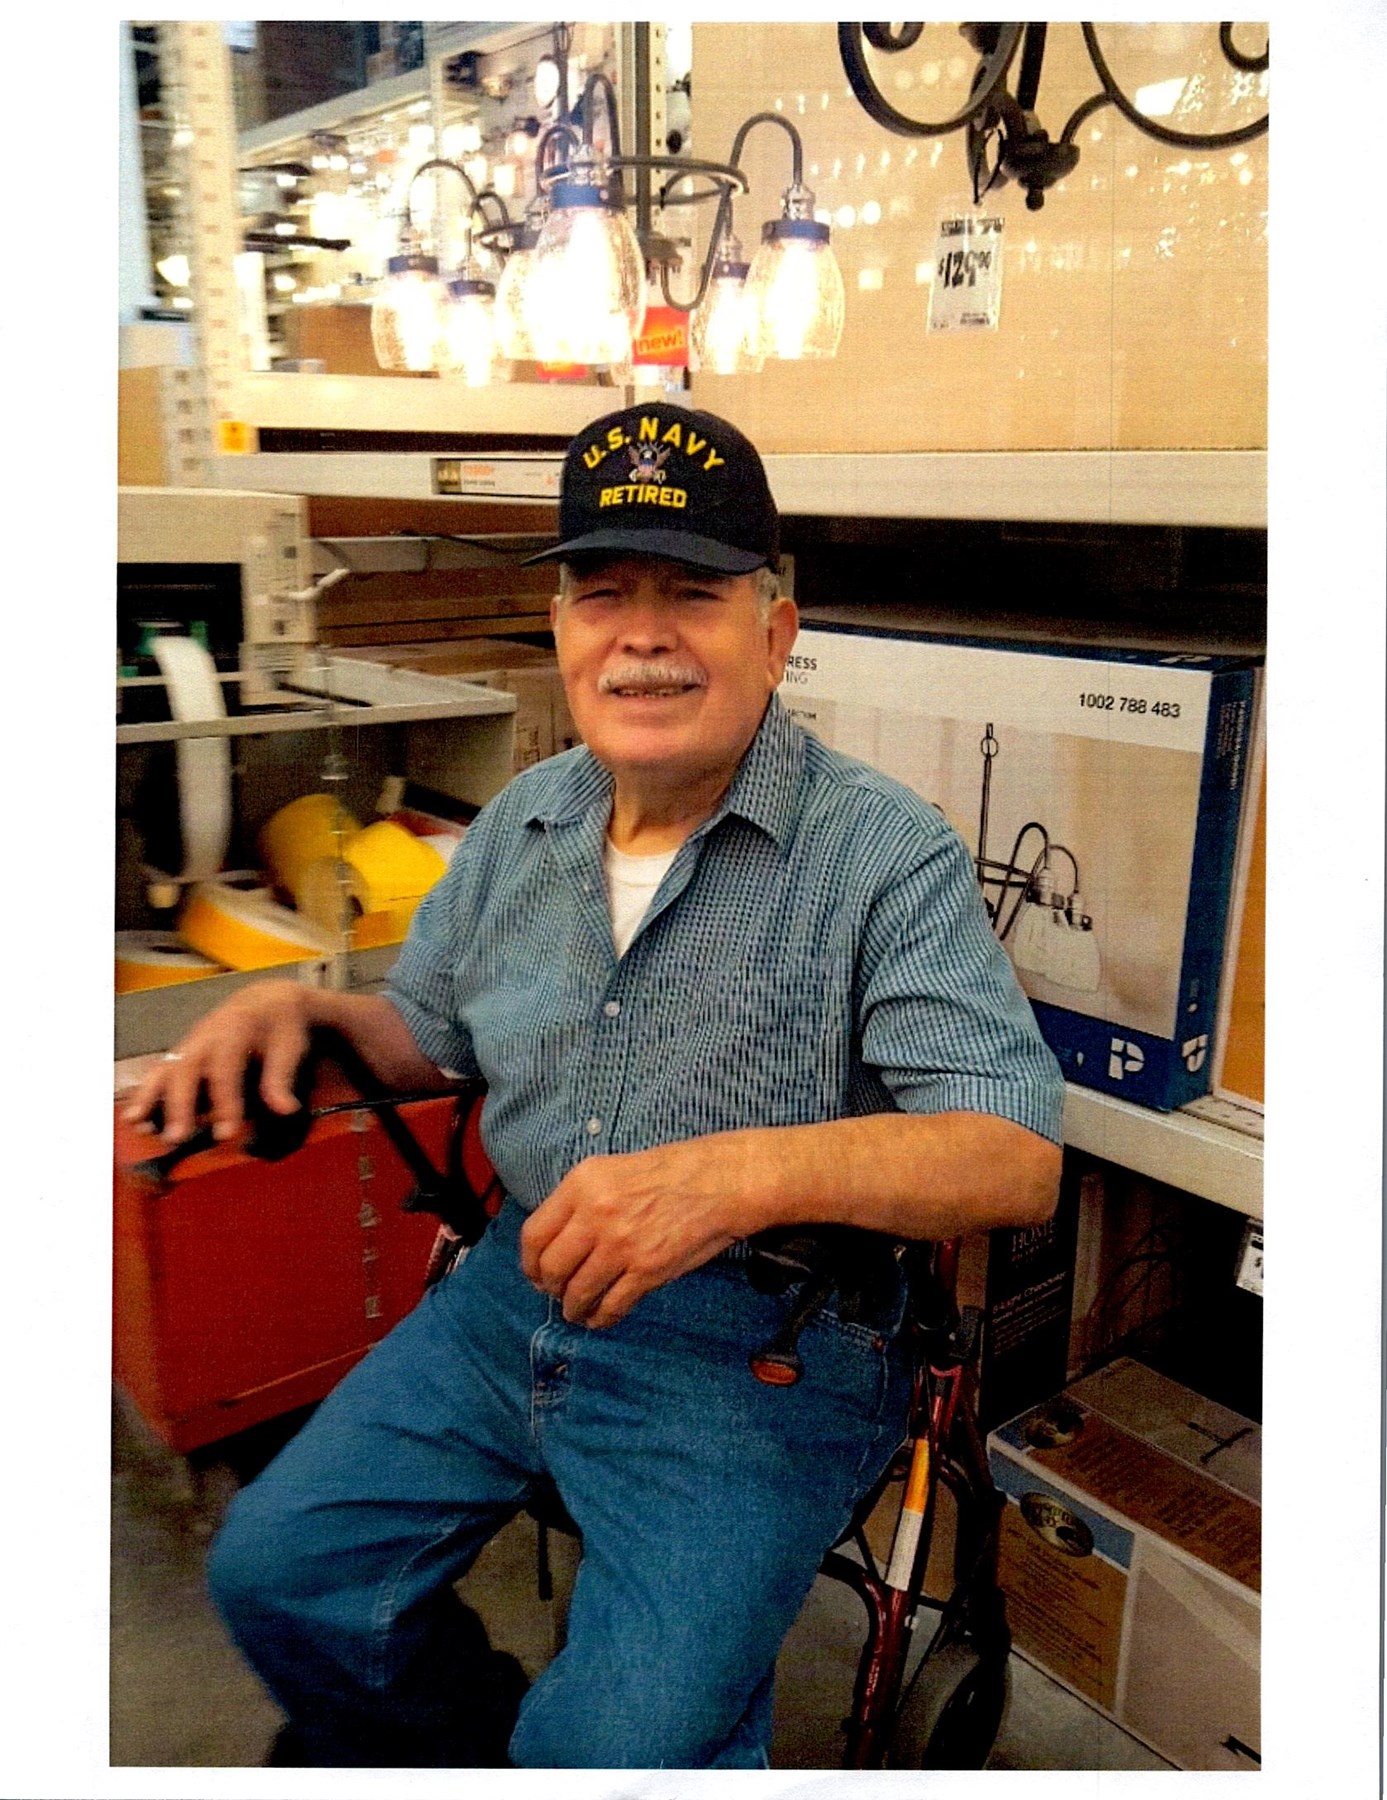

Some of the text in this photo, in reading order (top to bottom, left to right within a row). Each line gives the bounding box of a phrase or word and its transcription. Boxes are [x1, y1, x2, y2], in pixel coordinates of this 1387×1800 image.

[639, 328, 683, 352] new!
[583, 417, 725, 471] U.S. NAVY
[600, 484, 688, 508] RETIRED
[1079, 692, 1181, 718] 1002 788 483
